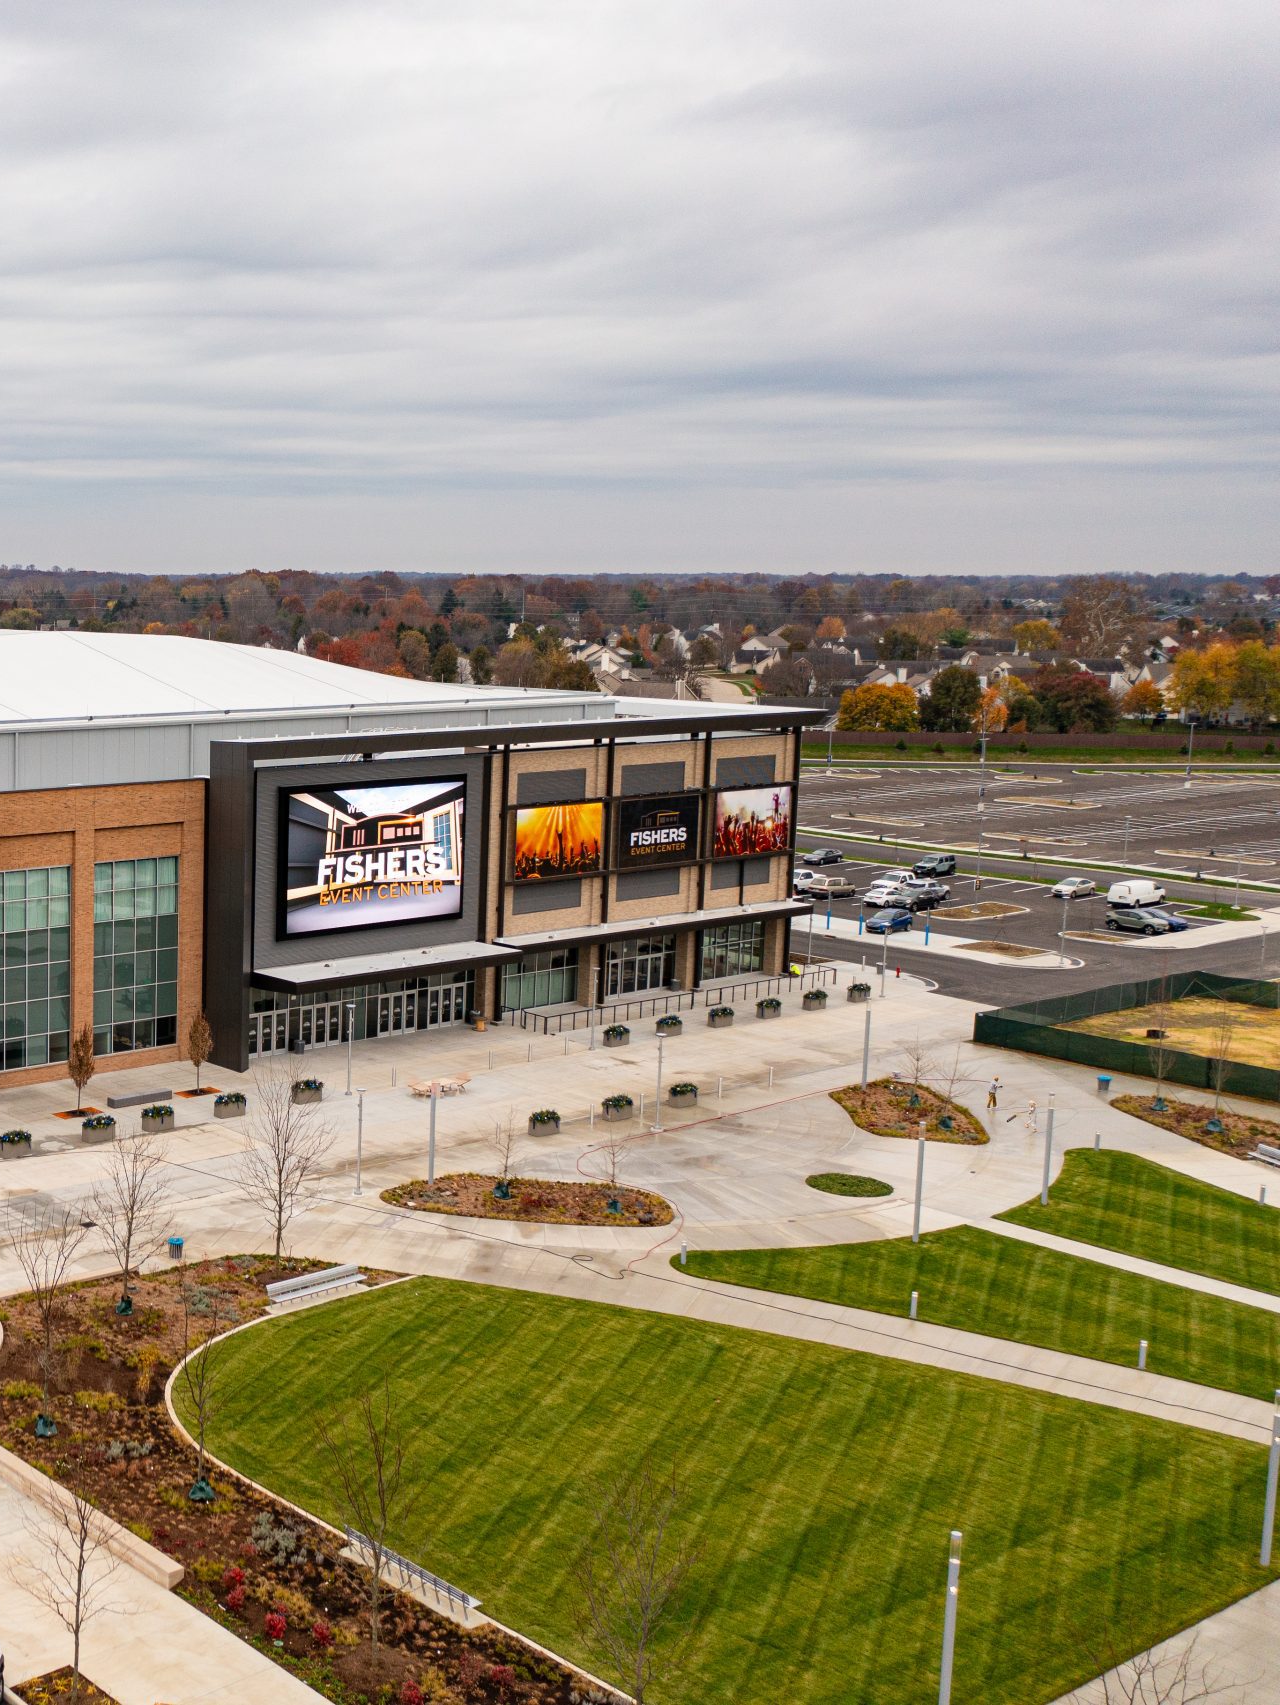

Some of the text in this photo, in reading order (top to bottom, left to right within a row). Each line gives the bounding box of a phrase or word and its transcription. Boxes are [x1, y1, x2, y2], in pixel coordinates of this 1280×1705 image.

[630, 827, 687, 846] FISHERS
[631, 843, 686, 855] EVENT CENTER
[317, 846, 447, 886] FISHERS
[319, 879, 444, 906] EVENT CENTER
